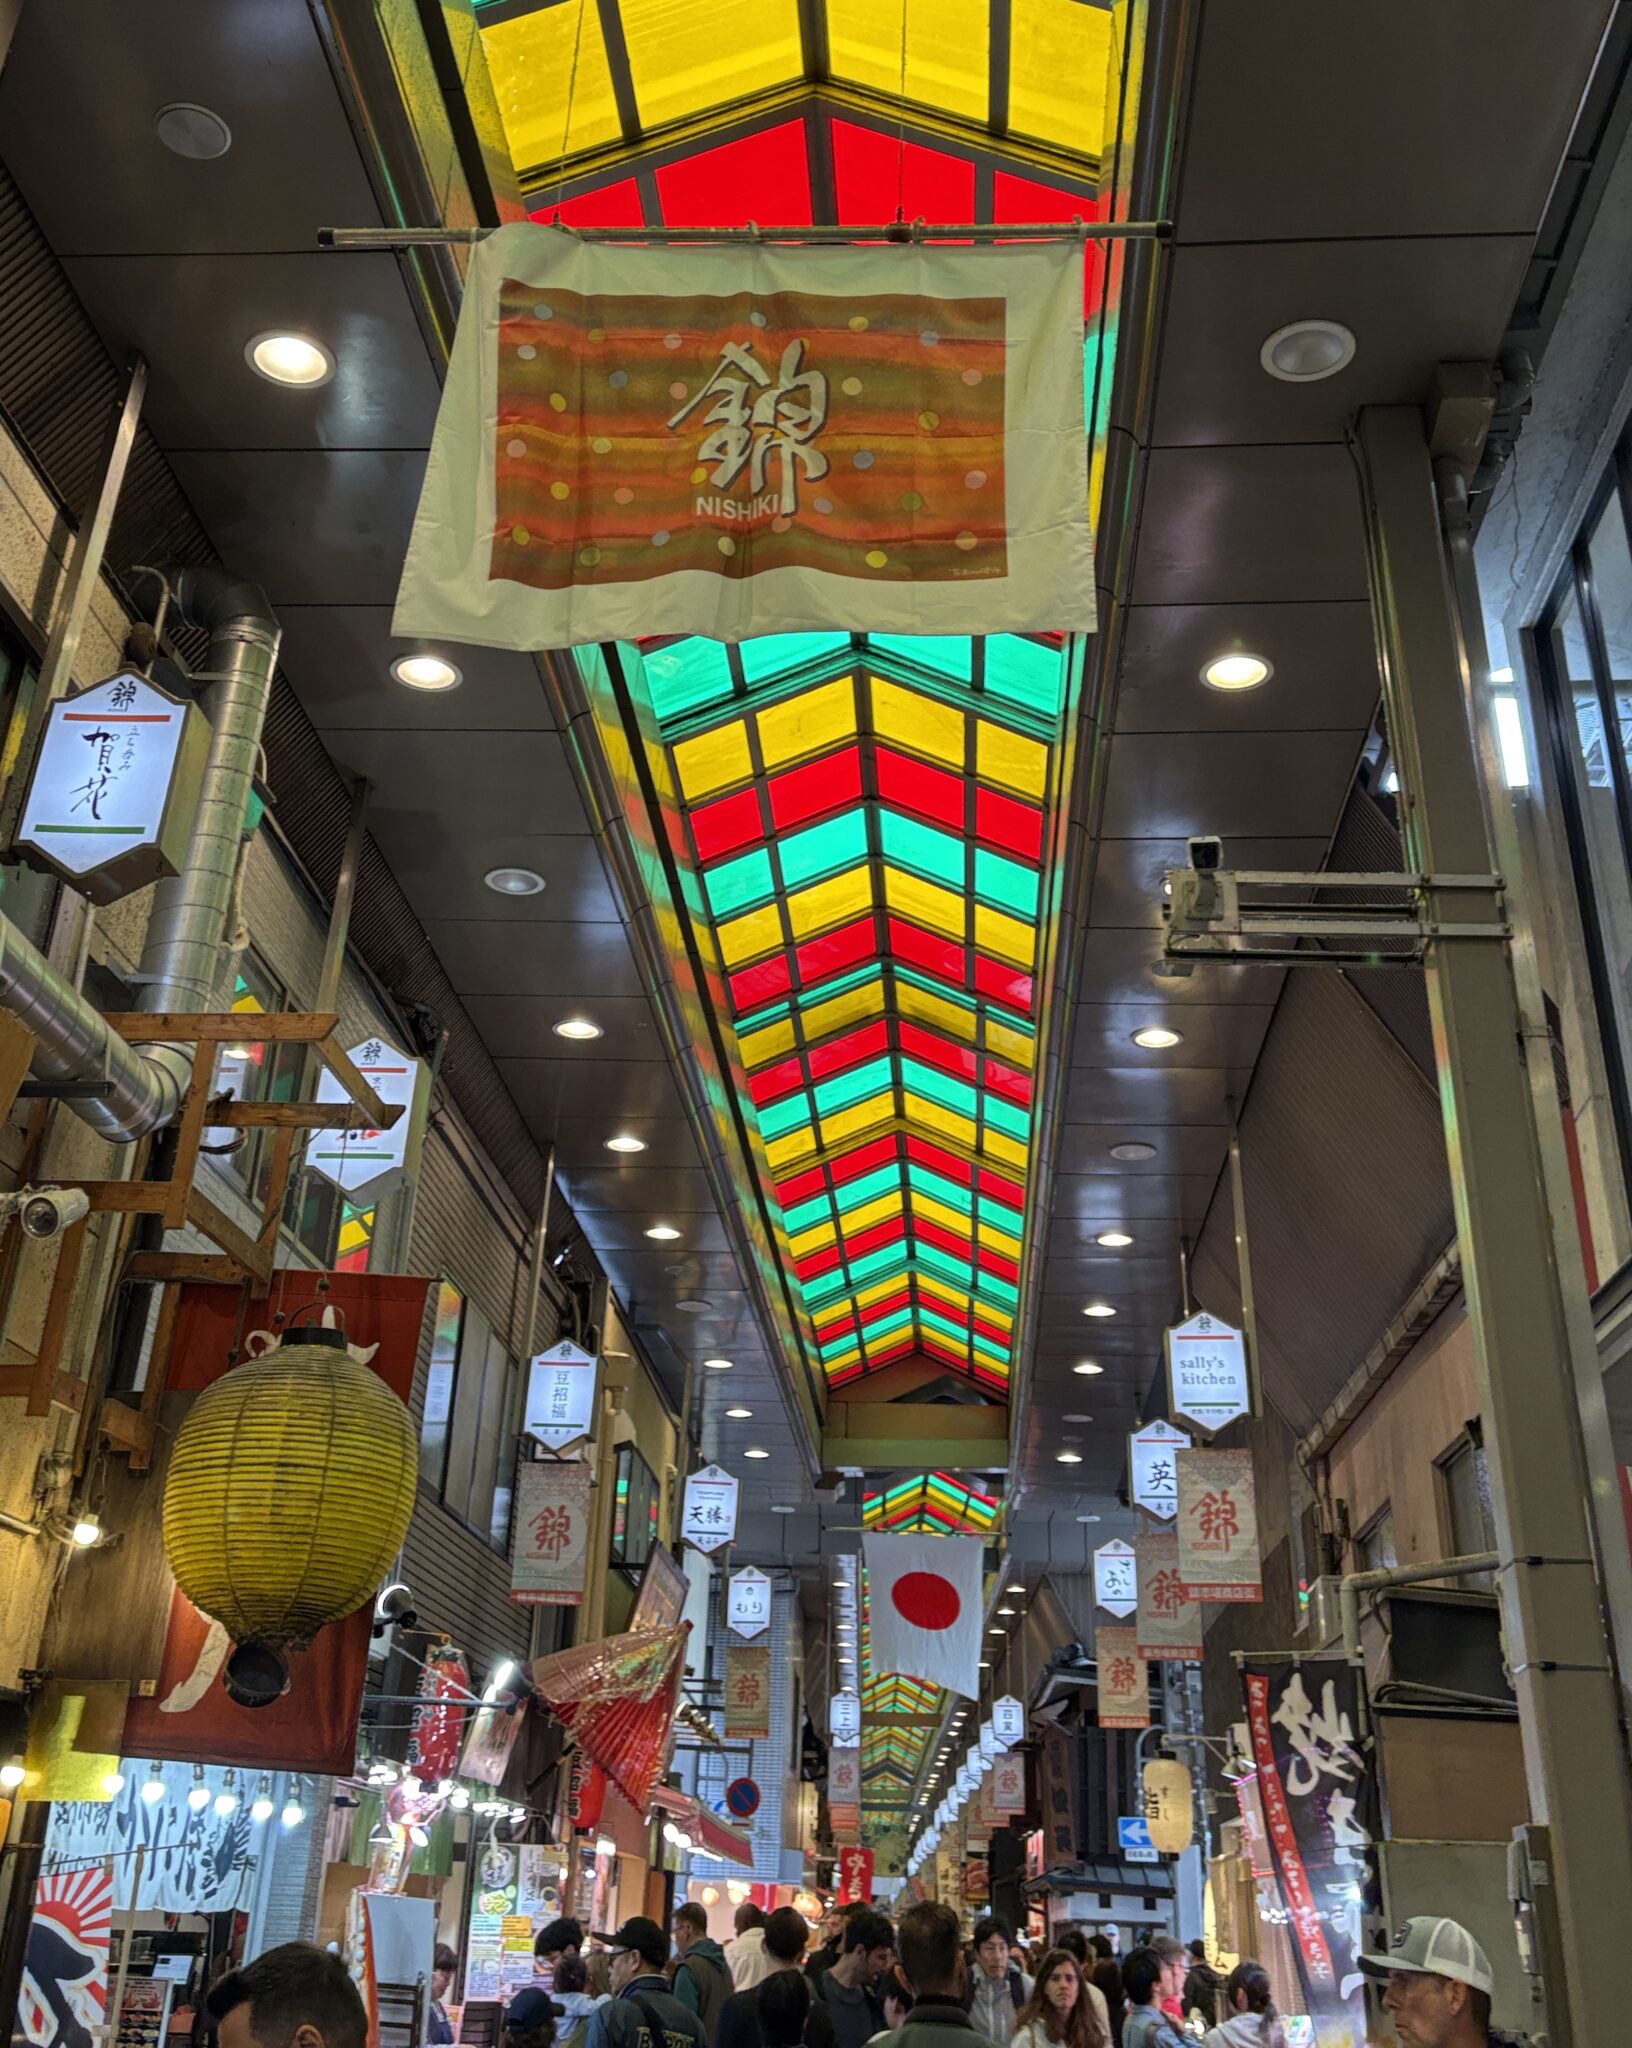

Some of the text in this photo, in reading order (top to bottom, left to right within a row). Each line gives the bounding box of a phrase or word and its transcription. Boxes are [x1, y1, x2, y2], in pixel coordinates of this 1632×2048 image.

[667, 338, 831, 518] 錦
[696, 494, 779, 521] NISHIKI
[1180, 1356, 1225, 1372] sally's
[1181, 1372, 1237, 1385] kitchen
[1147, 1460, 1177, 1491] 英
[528, 1504, 571, 1562] 錦
[1189, 1489, 1240, 1553] 錦
